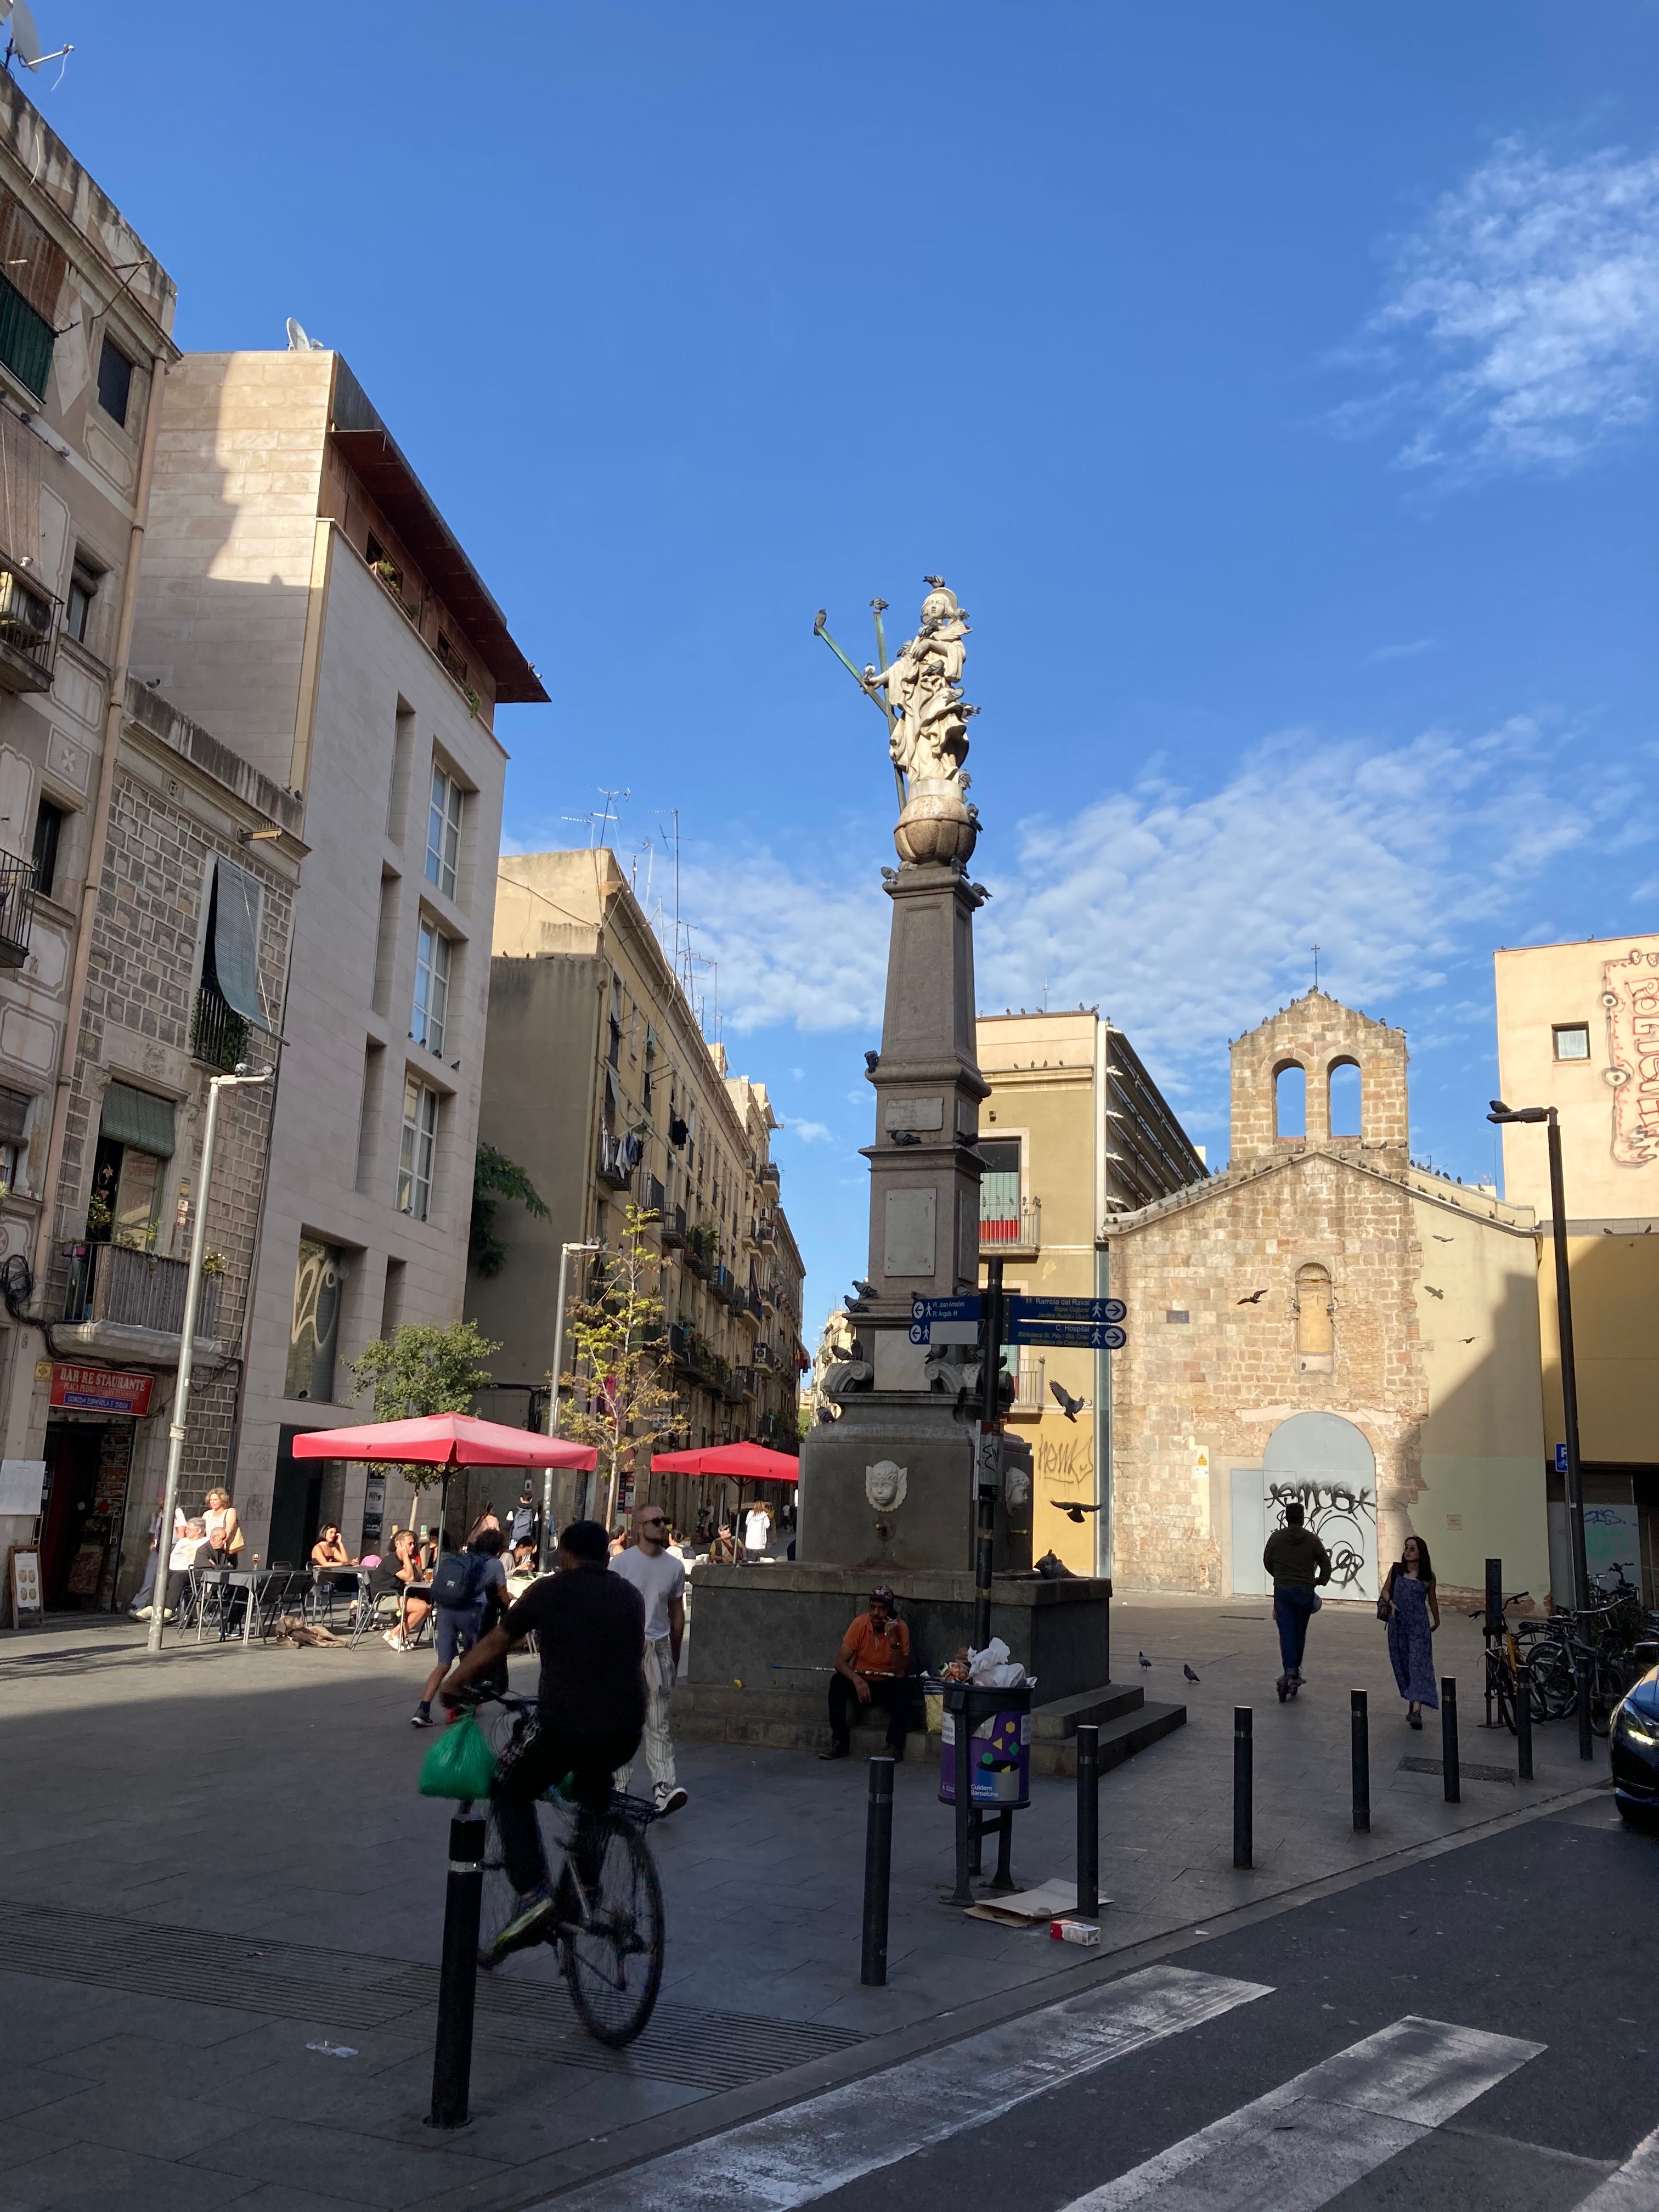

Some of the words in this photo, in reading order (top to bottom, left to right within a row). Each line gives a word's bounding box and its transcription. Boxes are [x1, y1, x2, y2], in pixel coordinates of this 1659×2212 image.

[1064, 1325, 1090, 1333] Hospital
[80, 1384, 96, 1393] PEDRO
[67, 1395, 86, 1404] COMIDA
